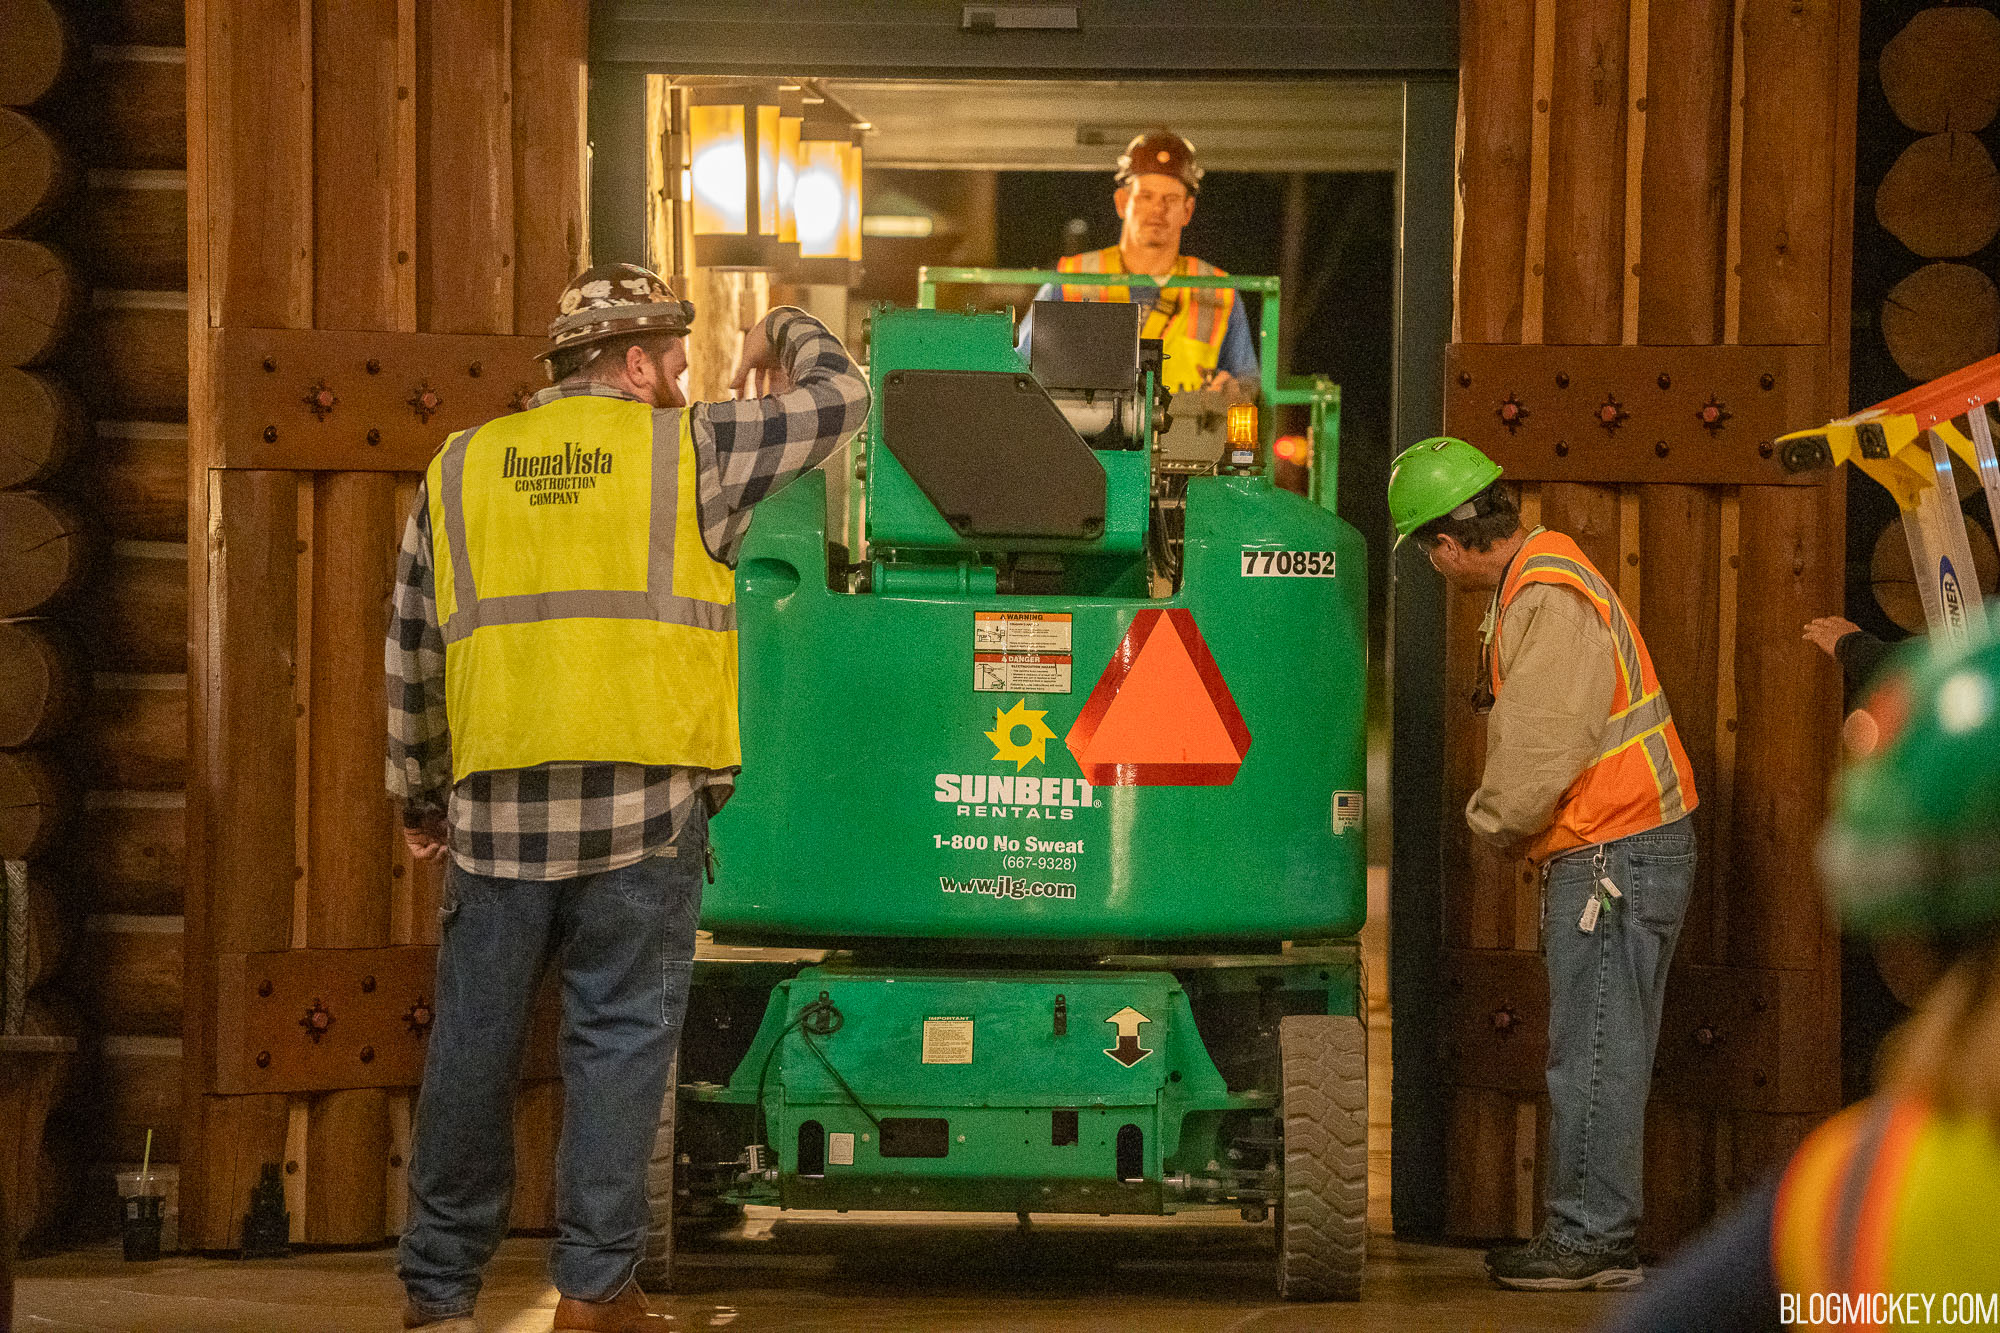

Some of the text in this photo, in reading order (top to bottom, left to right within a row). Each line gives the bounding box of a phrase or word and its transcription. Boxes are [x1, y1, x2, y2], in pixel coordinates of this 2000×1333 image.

[515, 476, 596, 492] CONSTRUCTION
[529, 491, 580, 506] COMPANY
[1243, 551, 1335, 576] 770852
[1006, 613, 1043, 621] WARNING
[1008, 655, 1041, 663] DANGER
[957, 804, 1074, 820] RENTALS
[933, 834, 1084, 854] 1-800 No Sweat
[1002, 854, 1077, 872] (667-9328)
[939, 875, 1077, 899] www.jlg.com
